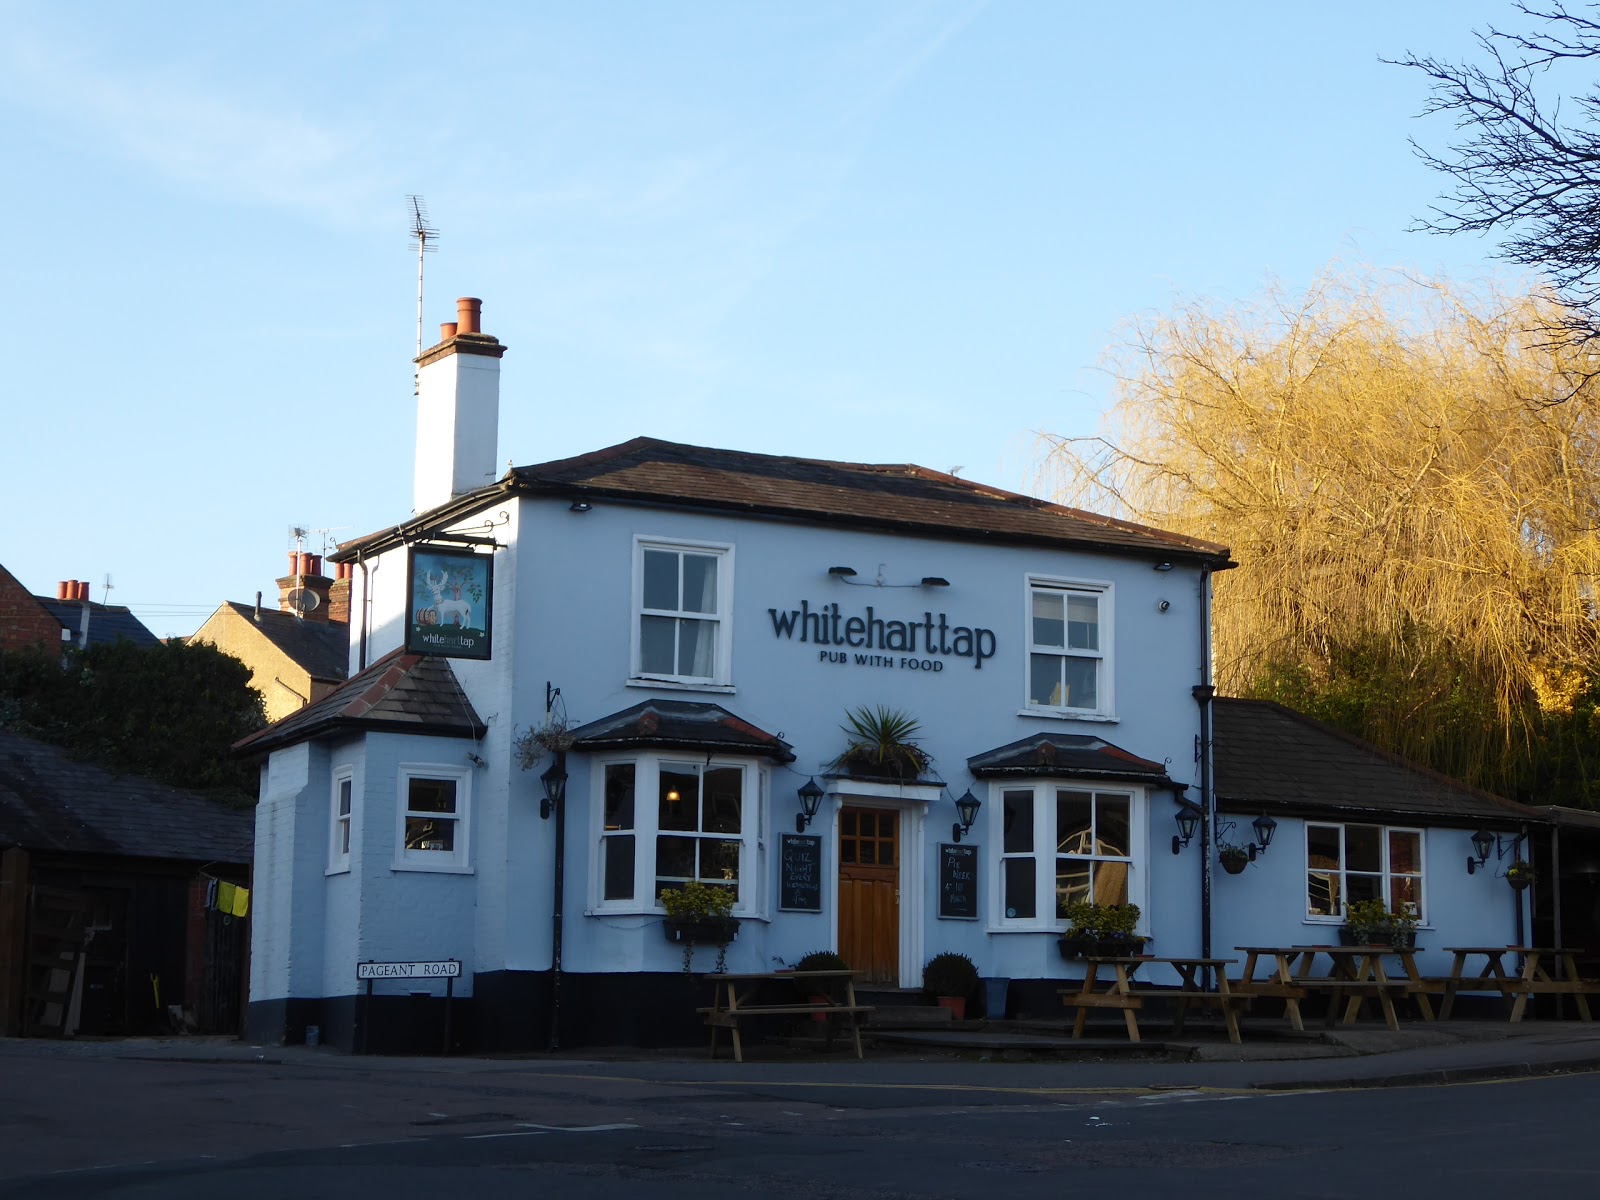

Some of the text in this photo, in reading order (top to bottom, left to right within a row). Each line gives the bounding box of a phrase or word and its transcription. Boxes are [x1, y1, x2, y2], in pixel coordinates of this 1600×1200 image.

[768, 600, 997, 669] whiteharttap
[820, 650, 944, 673] PUB WITH FOOD
[947, 856, 961, 869] PIE
[361, 963, 457, 976] PAGEANT ROAD
